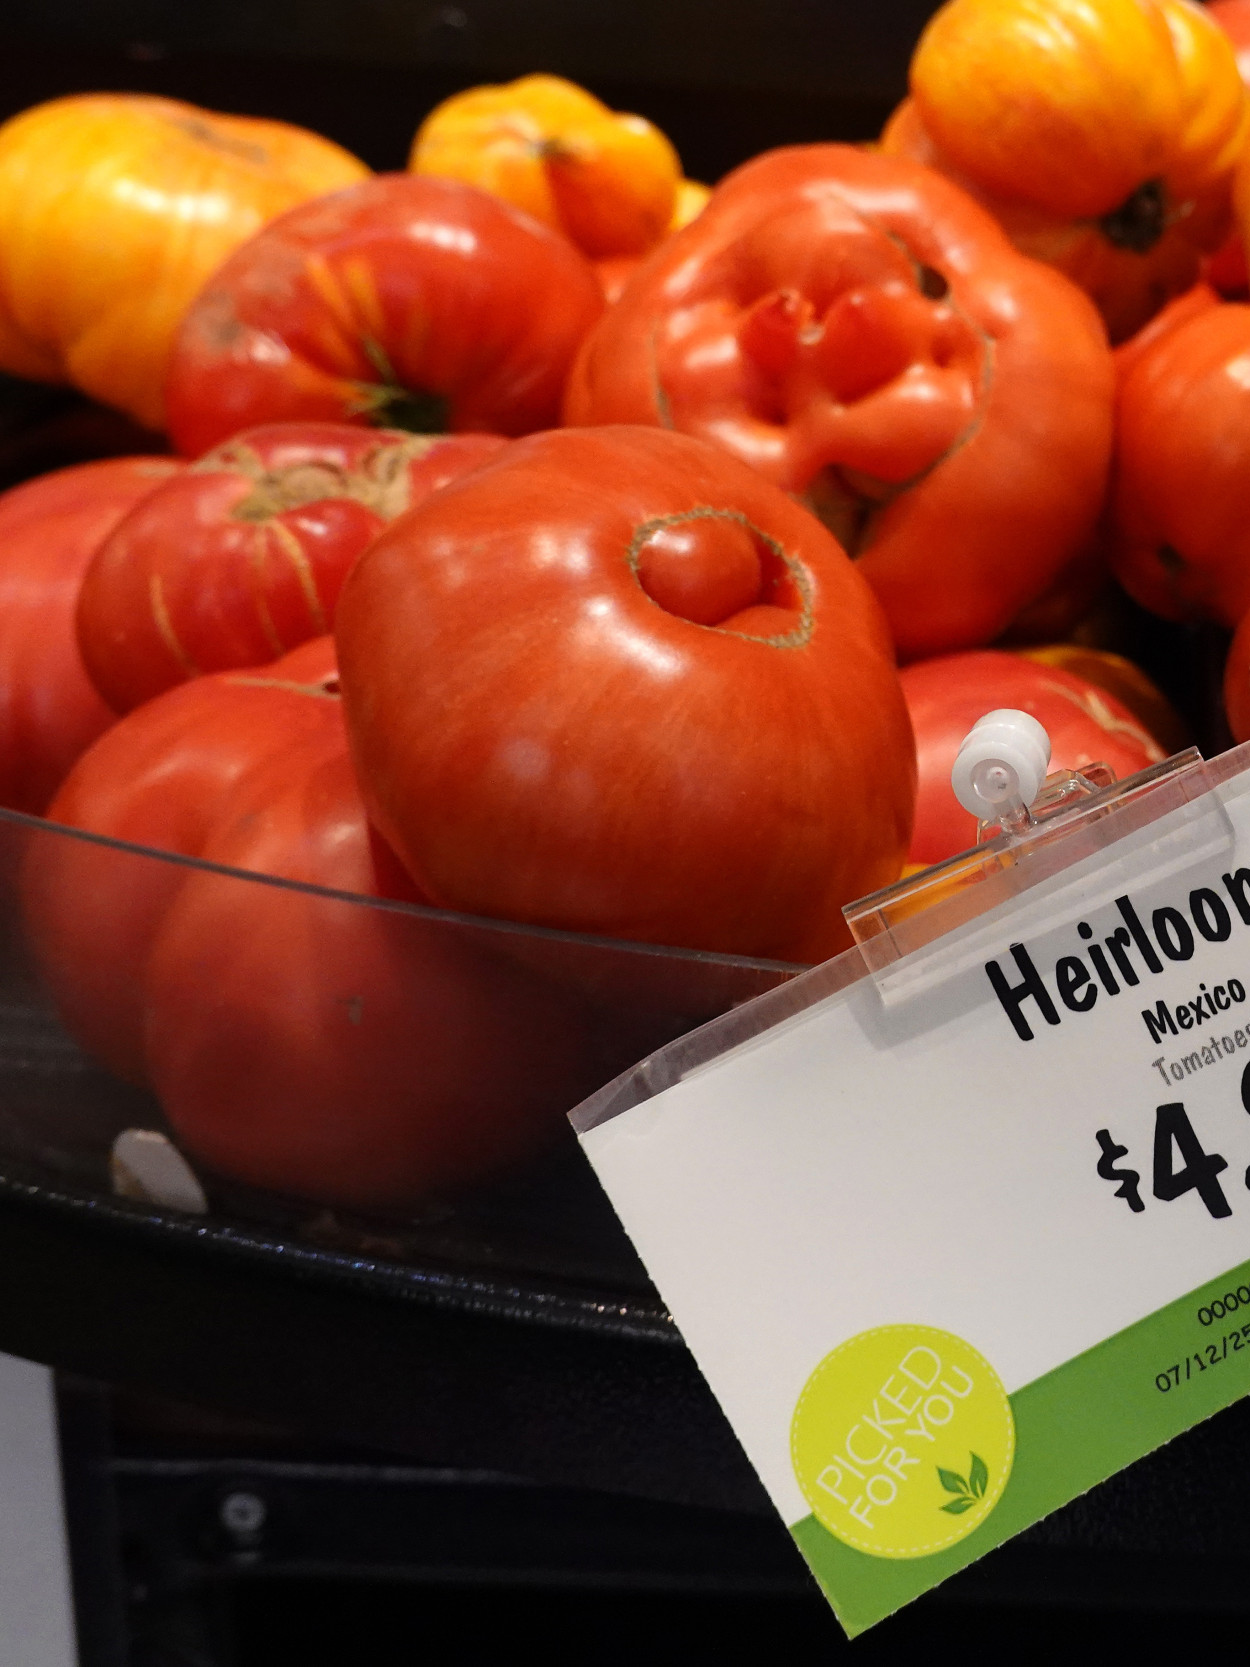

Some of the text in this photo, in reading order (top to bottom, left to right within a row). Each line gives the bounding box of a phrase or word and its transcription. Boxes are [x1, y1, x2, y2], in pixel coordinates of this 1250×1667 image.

[1141, 978, 1247, 1044] Mexico
[815, 1345, 942, 1506] PICKED
[849, 1365, 974, 1530] FOR YOU
